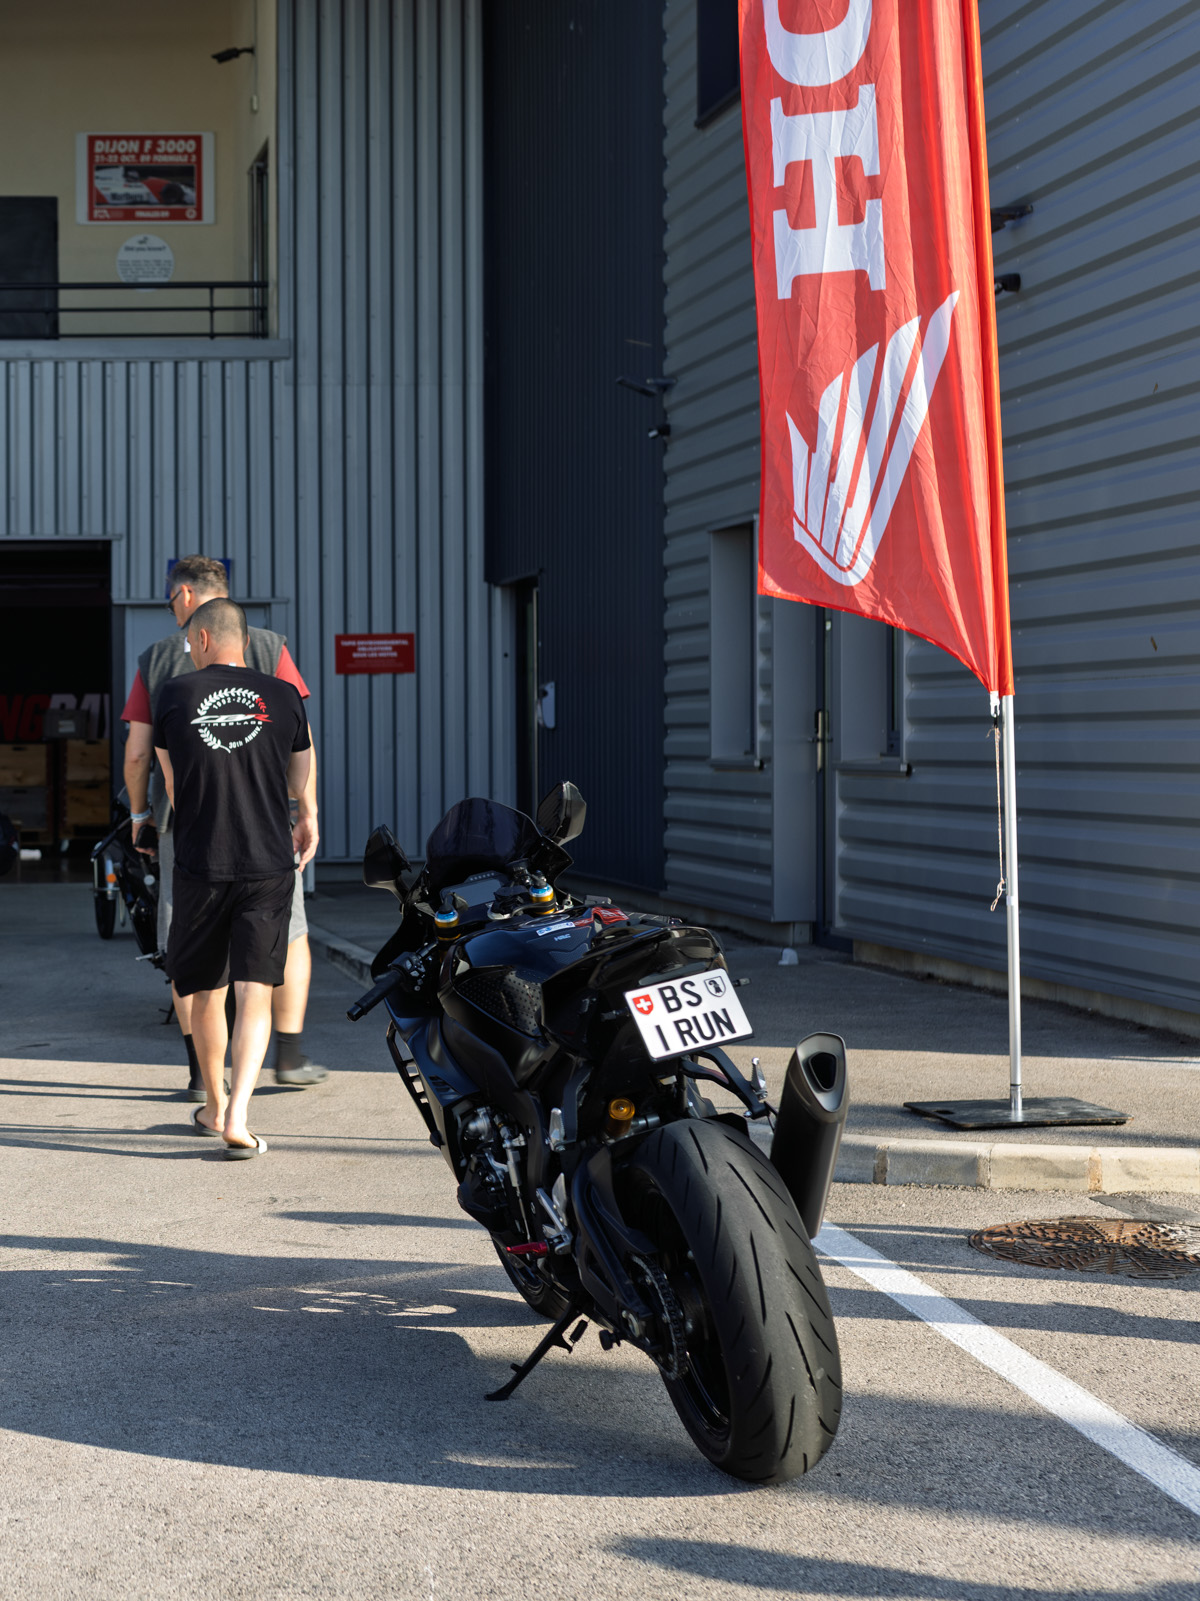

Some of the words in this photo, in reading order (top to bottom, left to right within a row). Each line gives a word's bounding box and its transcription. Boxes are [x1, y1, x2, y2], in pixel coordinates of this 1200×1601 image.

[94, 139, 140, 153] DIJON
[143, 139, 153, 153] F
[156, 139, 197, 153] 3000
[658, 980, 703, 1014] BS
[673, 1008, 737, 1047] RUN
